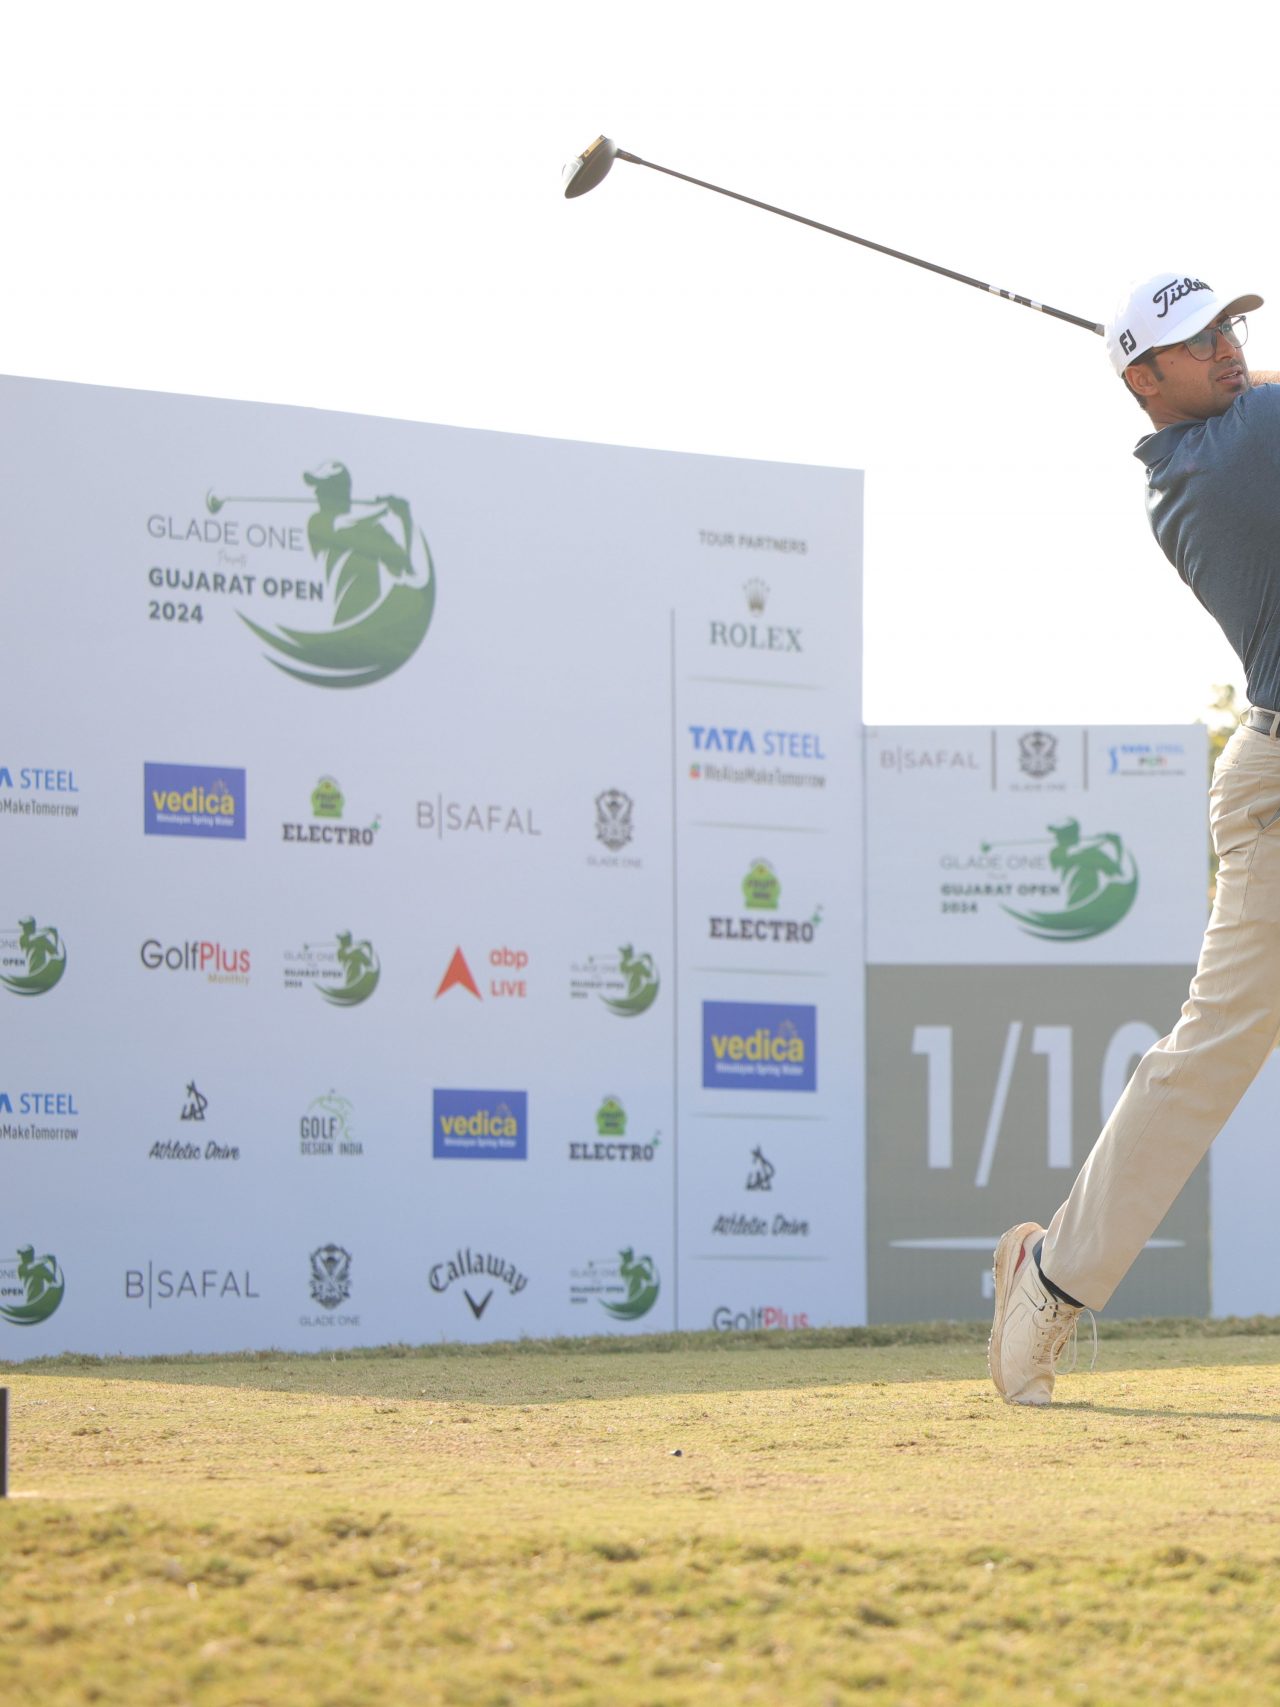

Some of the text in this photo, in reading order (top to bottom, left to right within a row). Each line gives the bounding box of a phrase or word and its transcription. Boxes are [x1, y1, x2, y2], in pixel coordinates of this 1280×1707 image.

[1119, 329, 1137, 356] FJ
[147, 514, 305, 552] GLADE ONE
[698, 529, 808, 555] TOUR PARTNERS
[148, 567, 324, 601] GUJARAT OPEN
[148, 601, 204, 624] 2024
[709, 620, 803, 652] ROLEX
[688, 726, 827, 760] TATA STEEL
[20, 768, 79, 792] STEEL
[153, 786, 235, 815] vedica
[282, 824, 373, 845] ELECTRO
[941, 883, 1060, 896] GUJARAT OPEN
[709, 917, 814, 943] ELECTRO
[3, 958, 26, 967] OPEN
[140, 939, 250, 972] GolfPlus
[489, 947, 528, 971] abp
[490, 980, 527, 998] LIVE
[711, 1029, 805, 1062] vedica
[20, 1093, 79, 1115] STEEL
[301, 1116, 337, 1139] GOLF
[440, 1110, 518, 1137] vedica
[149, 1140, 241, 1161] Athletic Drive
[340, 1141, 363, 1156] INDIA
[569, 1142, 654, 1161] ELECTRO
[712, 1213, 809, 1236] Athletic Drive
[428, 1247, 529, 1295] Callaway
[1, 1287, 24, 1297] OPEN
[299, 1314, 336, 1327] GLADE
[713, 1305, 809, 1331] GolfPlus
